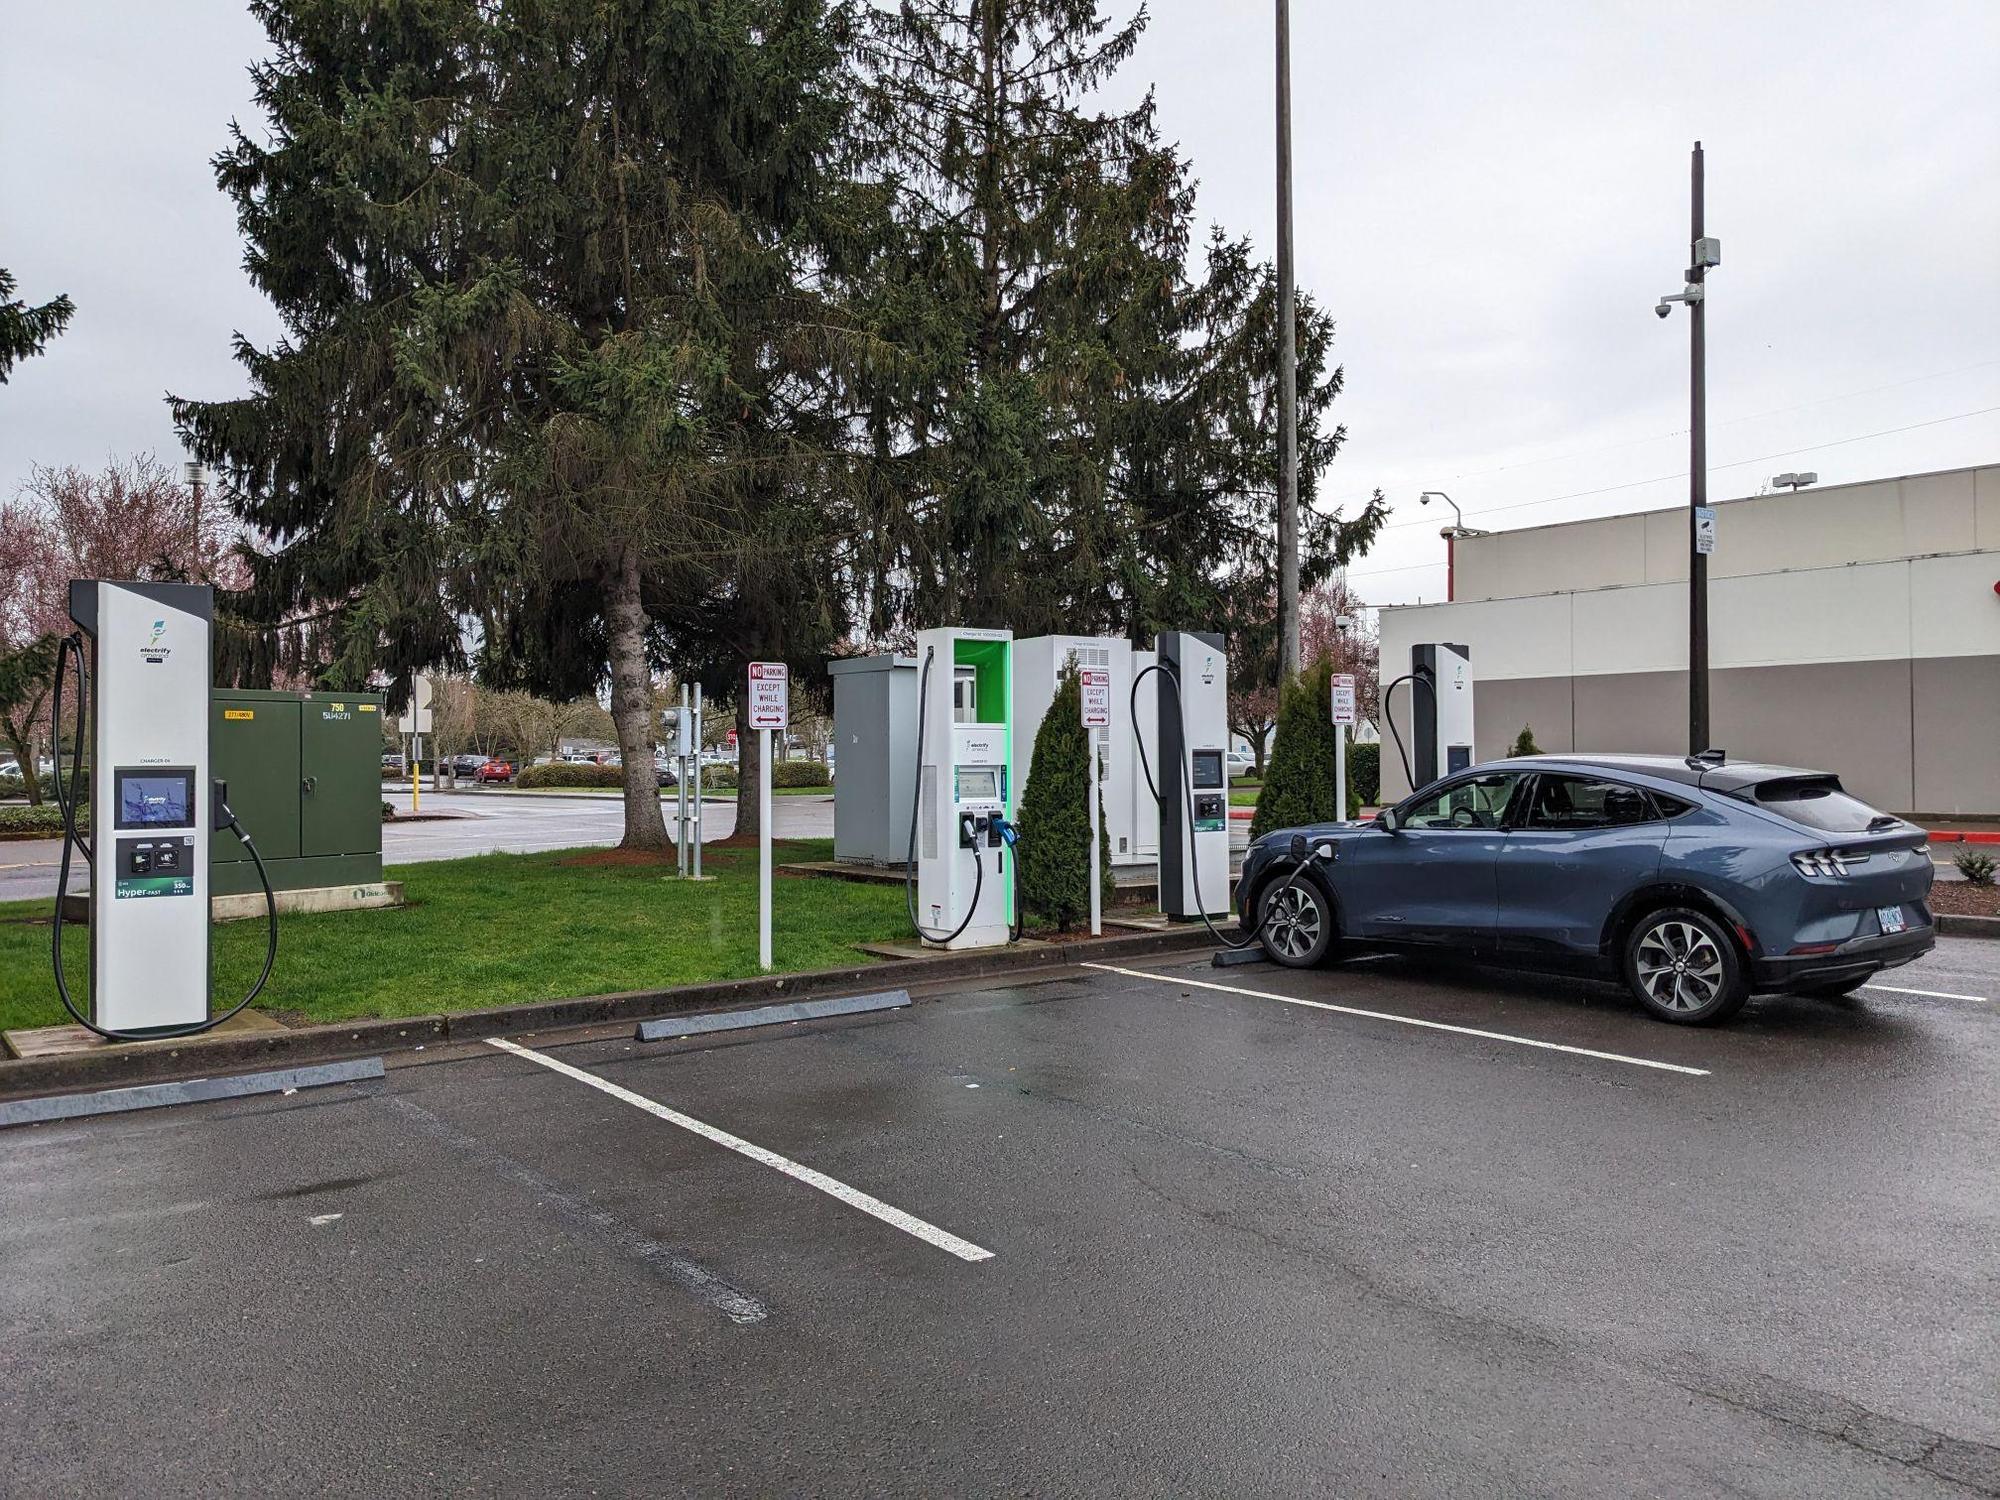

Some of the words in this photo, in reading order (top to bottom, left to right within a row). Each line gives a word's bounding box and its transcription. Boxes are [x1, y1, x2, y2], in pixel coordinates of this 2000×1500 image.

[140, 647, 171, 655] electrify
[752, 666, 762, 677] NO
[763, 668, 785, 677] PARKING
[1083, 674, 1091, 684] NO
[1091, 675, 1108, 683] PARKING
[756, 683, 780, 692] EXCEPT
[1087, 688, 1105, 696] EXCEPT
[759, 694, 778, 702] WHILE
[1088, 697, 1103, 705] WHILE
[331, 703, 344, 712] 750
[753, 704, 784, 713] CHARGING
